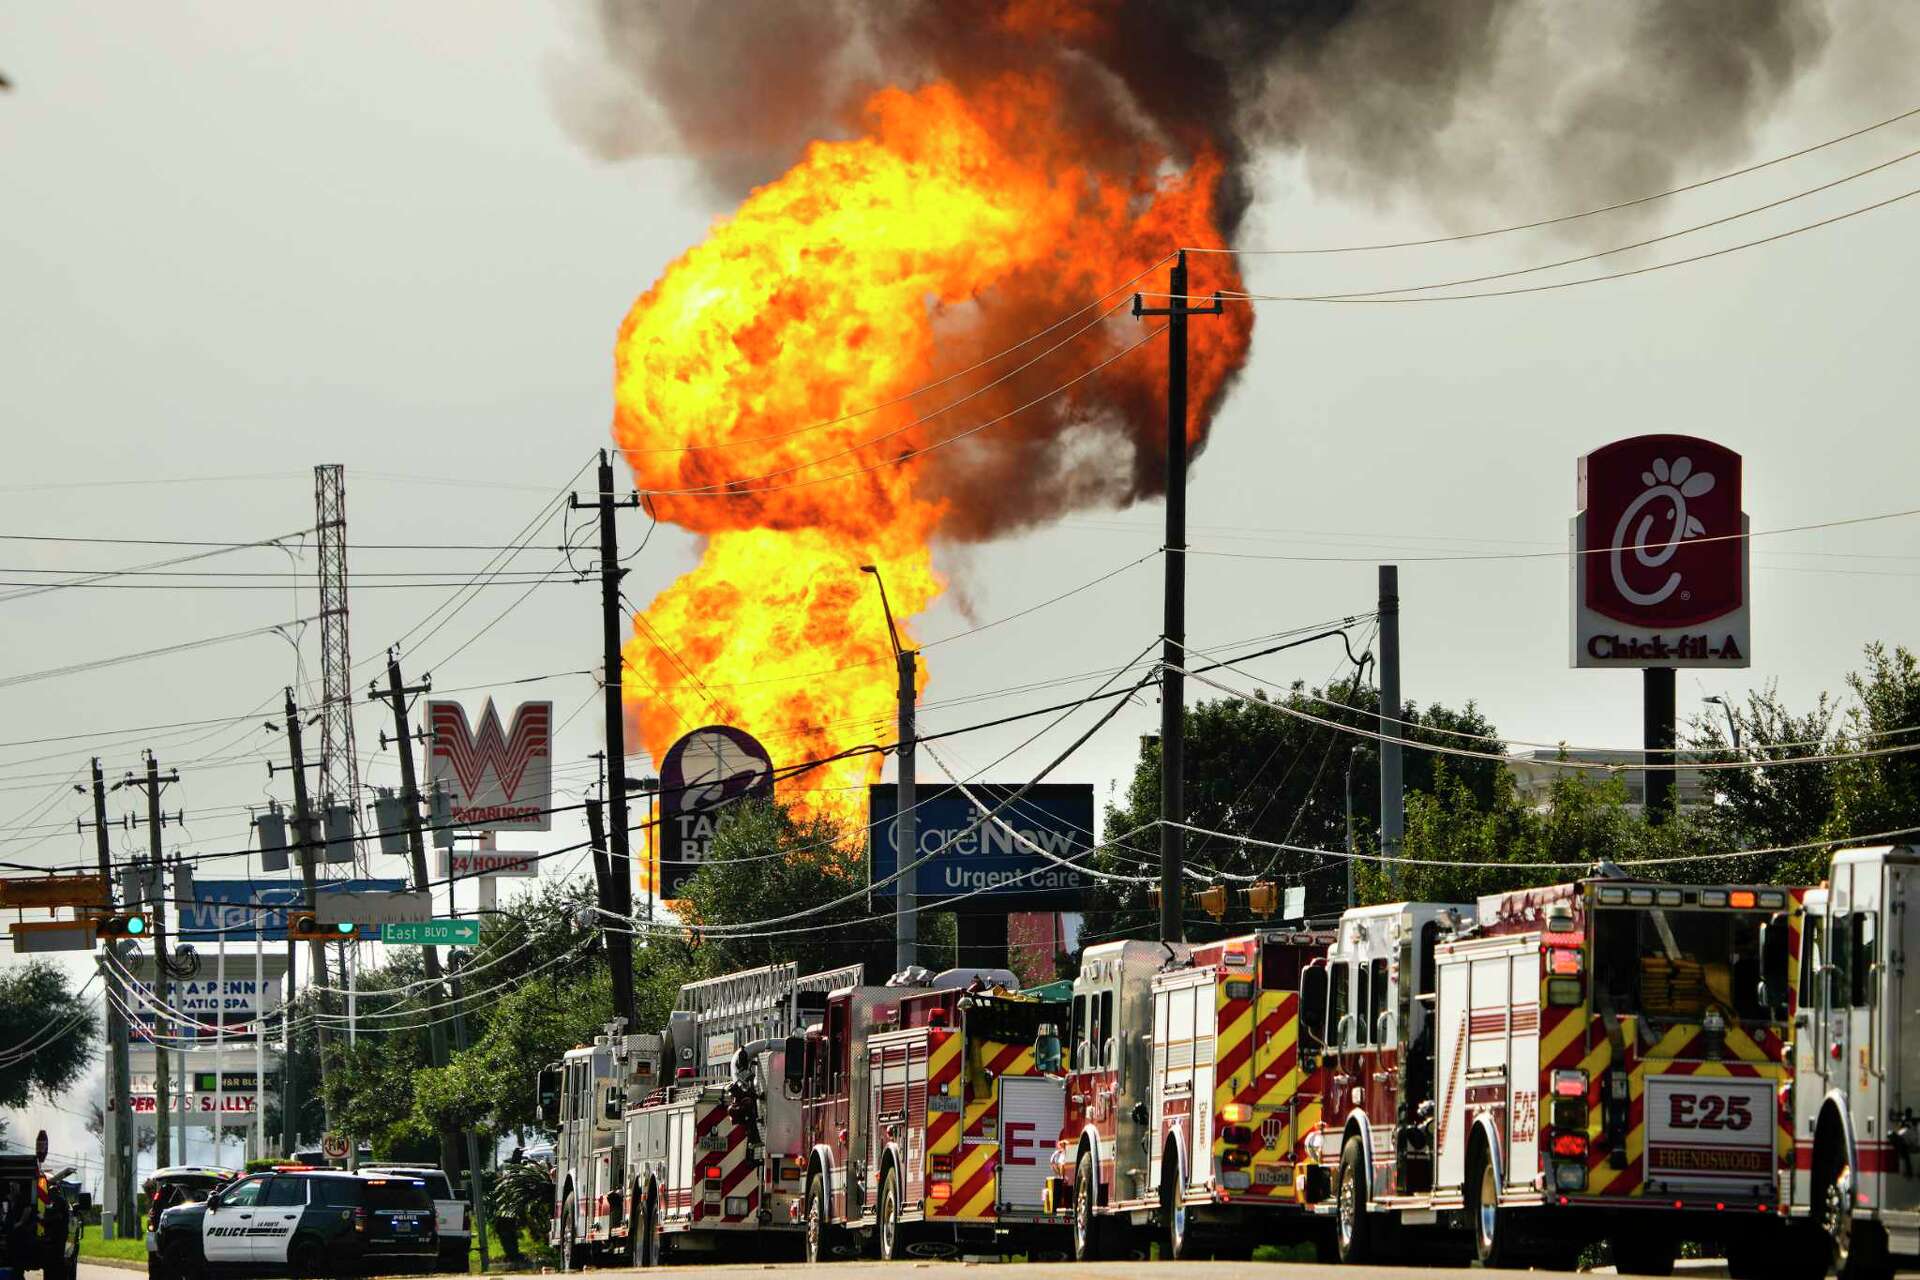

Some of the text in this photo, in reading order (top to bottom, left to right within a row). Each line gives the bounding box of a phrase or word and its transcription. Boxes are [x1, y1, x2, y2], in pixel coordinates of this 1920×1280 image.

[1587, 634, 1743, 659] Chick-fil-A
[888, 818, 1077, 856] CareNow
[453, 856, 529, 873] 24 HOURS
[945, 866, 1081, 889] Urgent Care
[387, 923, 448, 940] East BLVD
[224, 999, 249, 1009] SPA
[1669, 1094, 1753, 1131] E25
[1658, 1151, 1761, 1169] FRIENDSWOOD
[207, 1227, 248, 1237] POLICE
